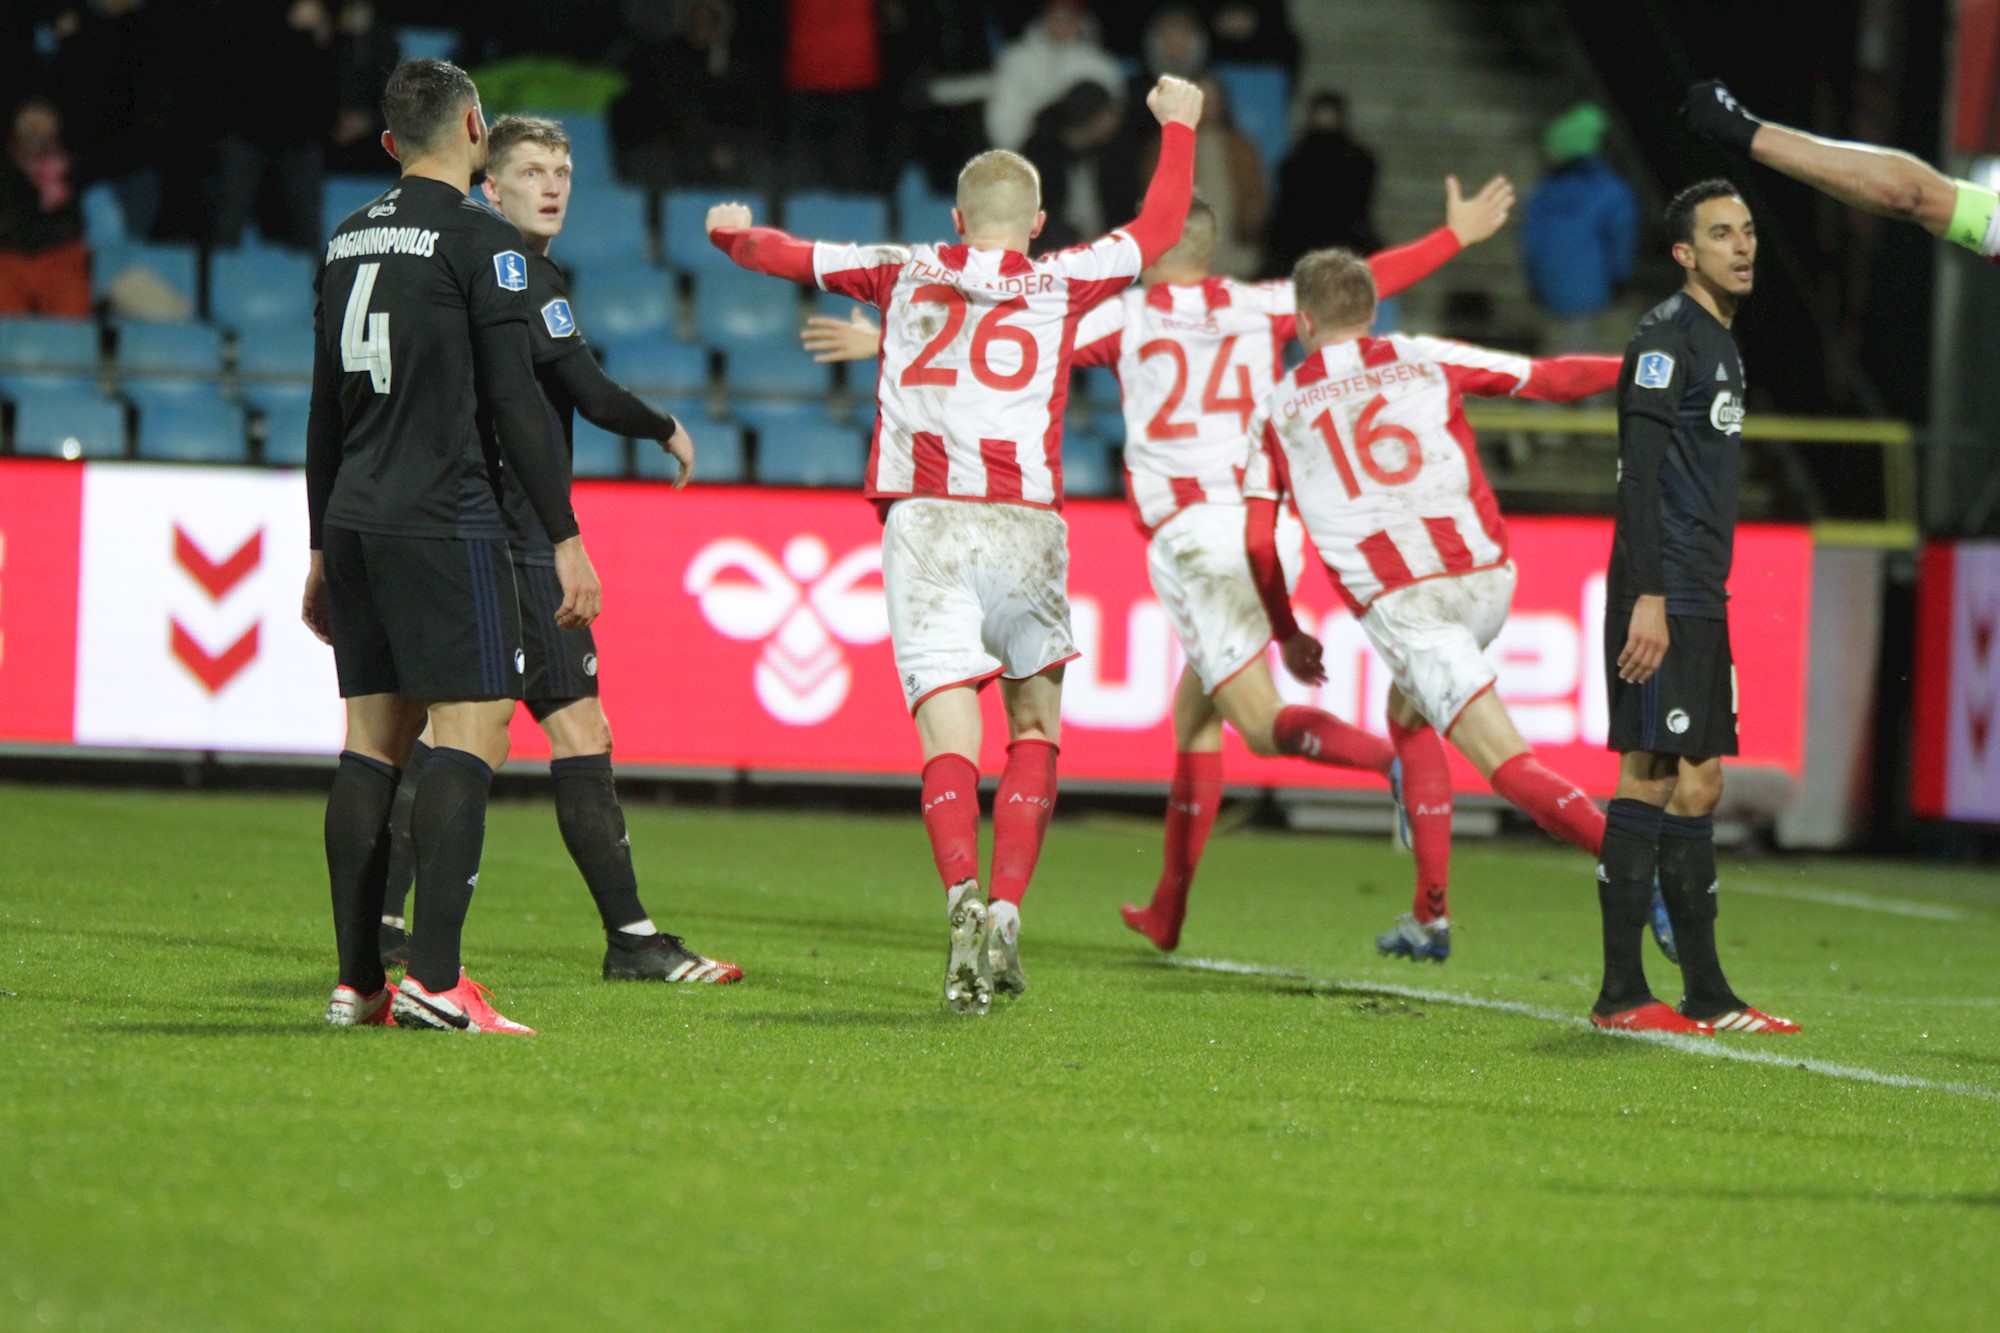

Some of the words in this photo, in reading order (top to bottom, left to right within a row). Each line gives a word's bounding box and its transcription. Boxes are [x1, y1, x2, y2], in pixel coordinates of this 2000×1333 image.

[341, 263, 391, 394] 4
[899, 283, 1040, 392] 26
[1138, 336, 1256, 440] 24
[1283, 363, 1428, 420] CHRISTENSEN
[1310, 393, 1424, 501] 16
